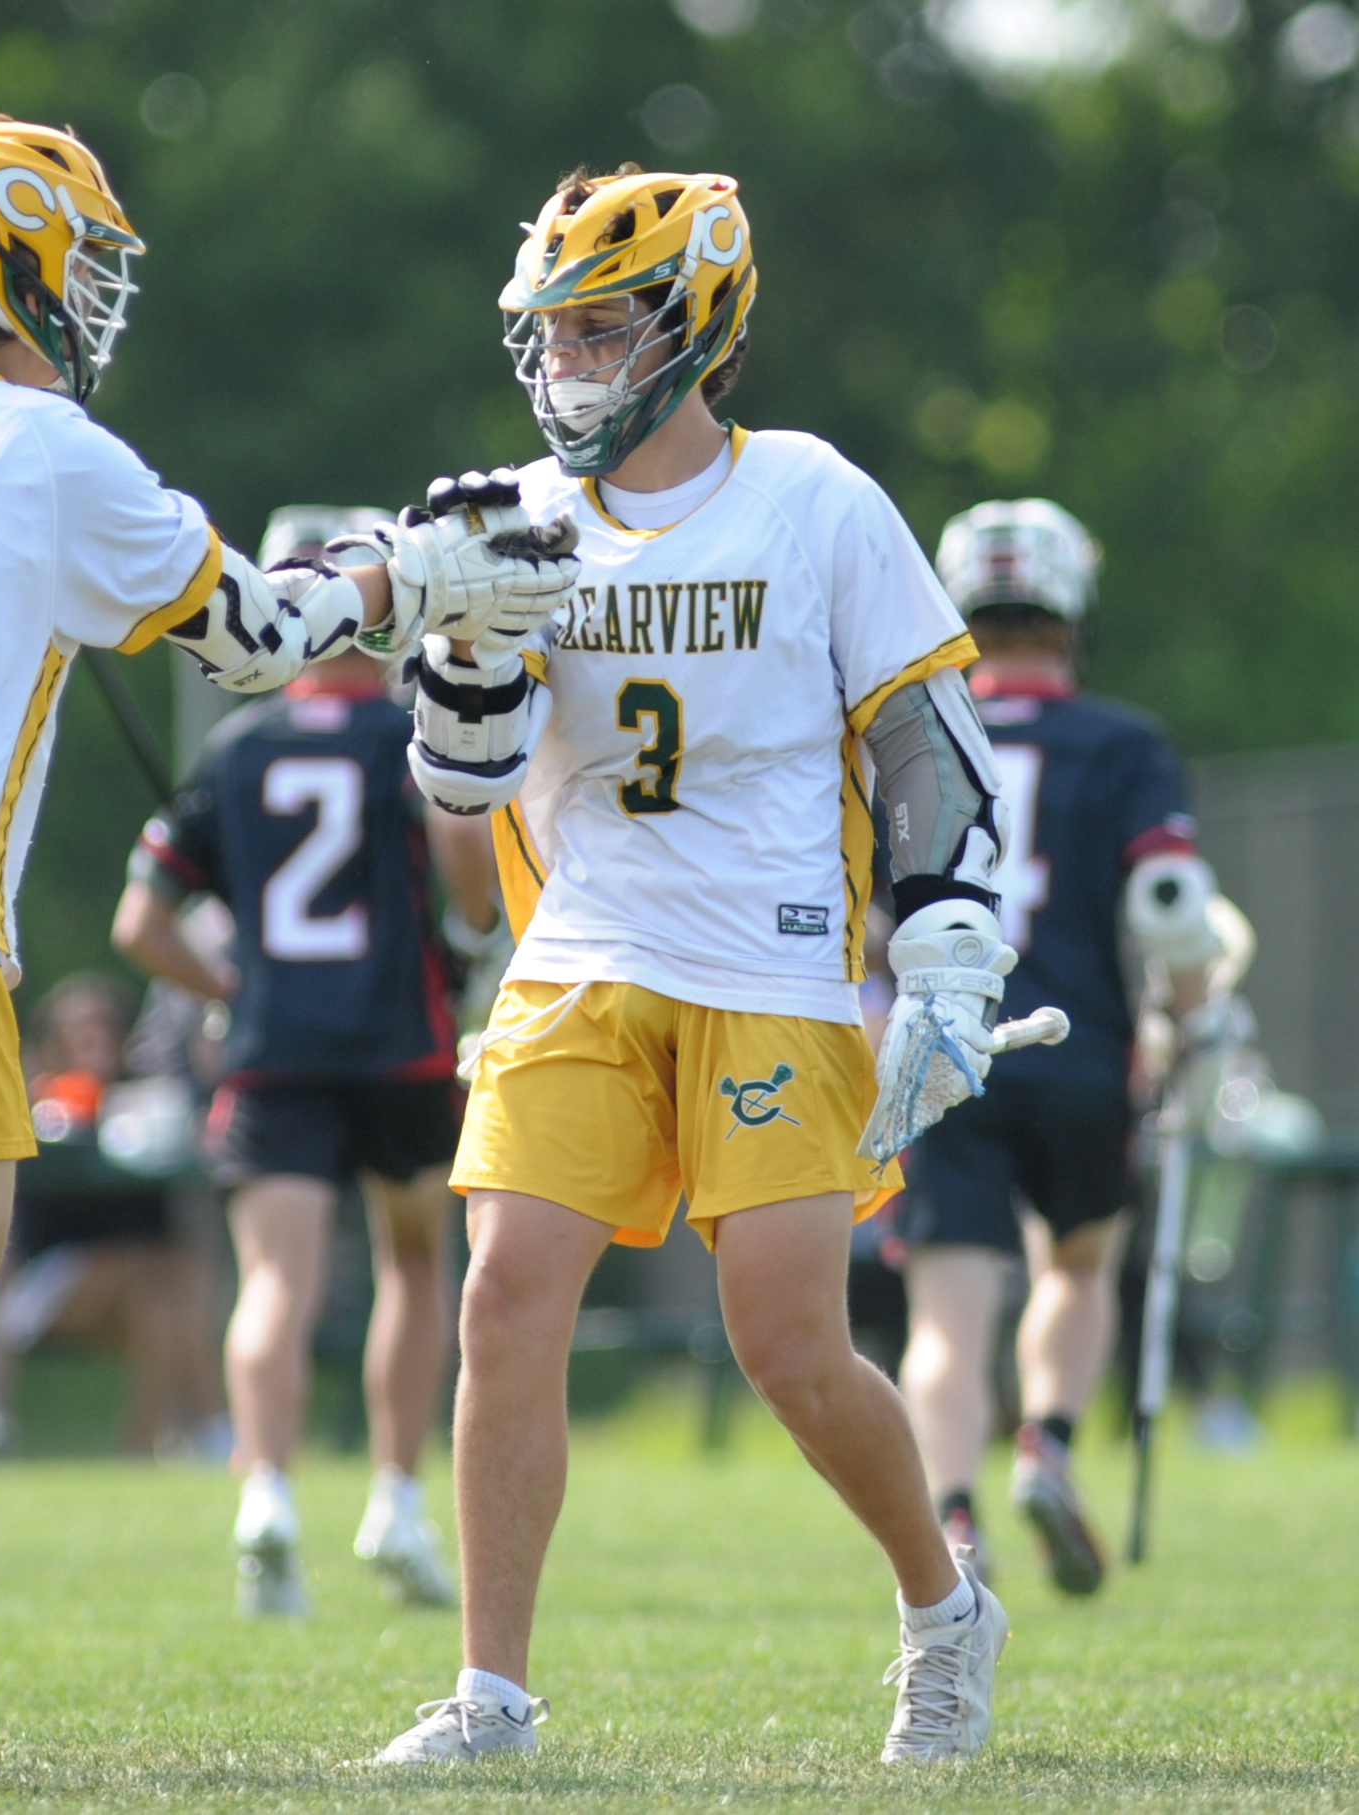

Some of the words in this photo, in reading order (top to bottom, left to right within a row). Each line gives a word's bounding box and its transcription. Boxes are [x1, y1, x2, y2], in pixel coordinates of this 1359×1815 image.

[553, 579, 768, 655] LEARVIEW
[614, 677, 684, 819] 3
[262, 756, 369, 962] 2
[894, 802, 910, 843] STX
